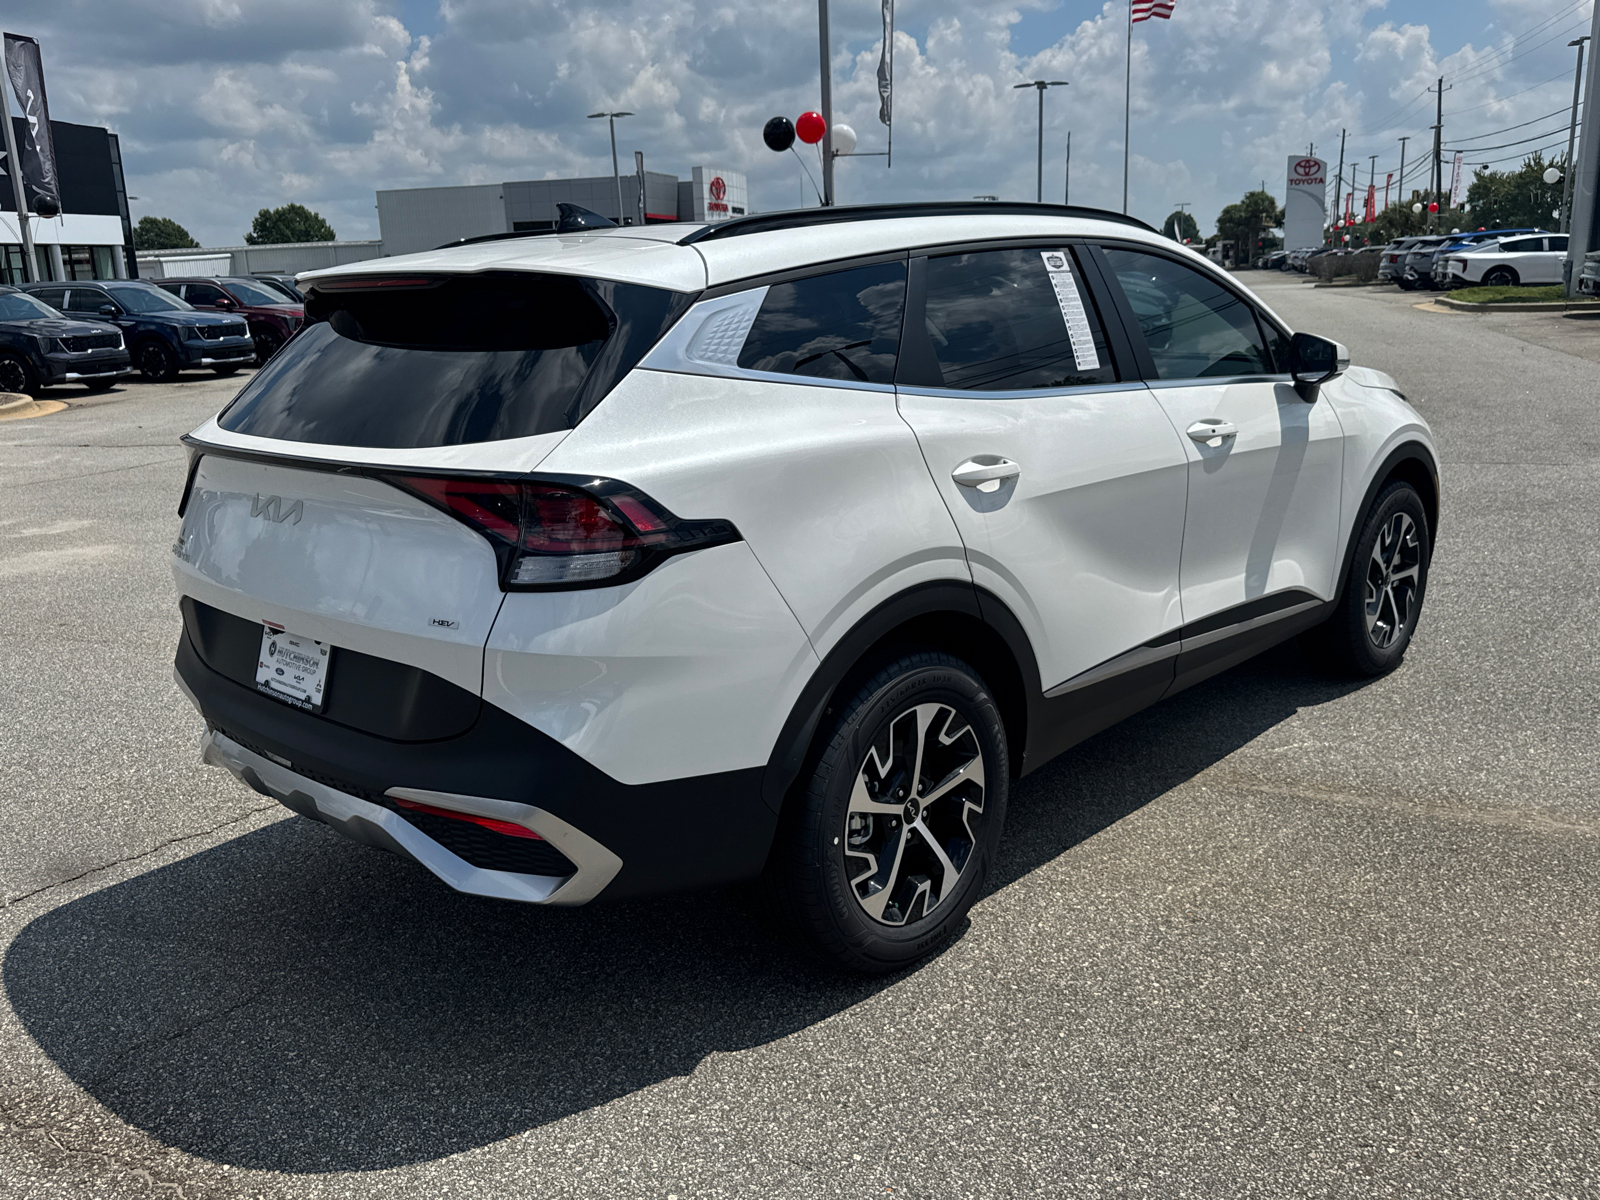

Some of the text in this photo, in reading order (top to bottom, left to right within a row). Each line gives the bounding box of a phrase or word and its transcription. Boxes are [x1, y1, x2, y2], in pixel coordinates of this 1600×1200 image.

[1289, 177, 1324, 186] TOYOTA
[708, 202, 729, 212] TOYOTA
[250, 492, 304, 526] KIA
[432, 618, 455, 627] HEV
[276, 646, 320, 669] HUTCHINSON
[276, 658, 301, 671] AUTOMOTIVE
[302, 665, 317, 675] GROUP
[825, 797, 849, 920] GOODYEAR
